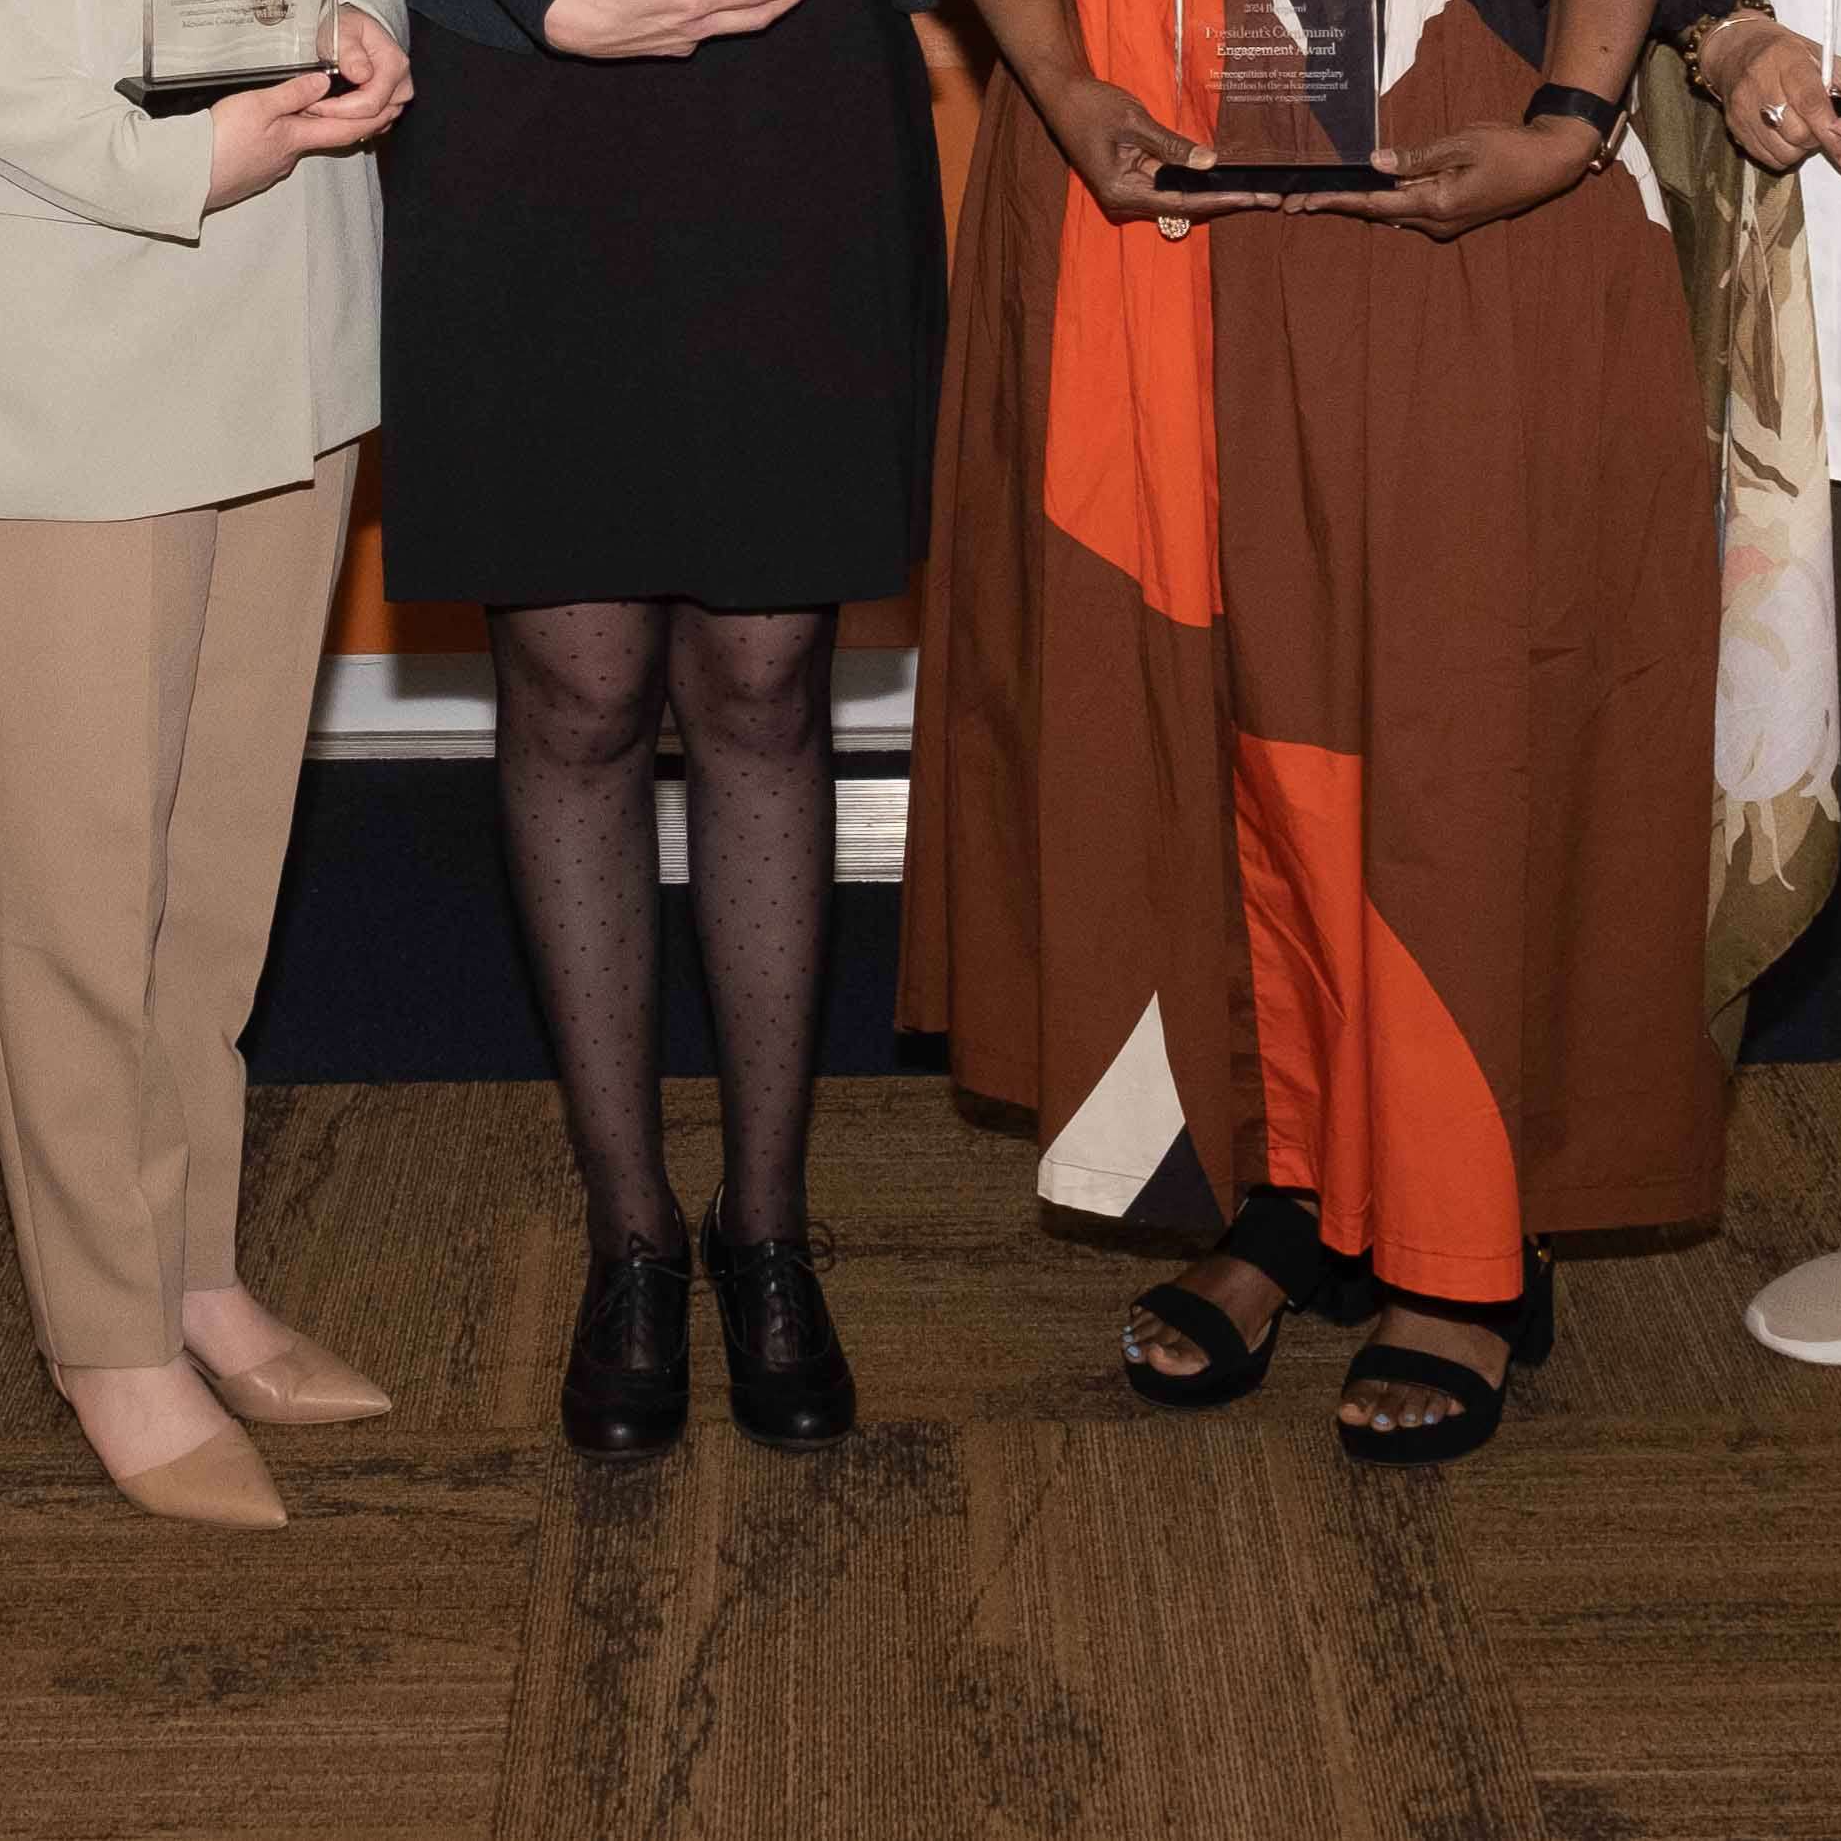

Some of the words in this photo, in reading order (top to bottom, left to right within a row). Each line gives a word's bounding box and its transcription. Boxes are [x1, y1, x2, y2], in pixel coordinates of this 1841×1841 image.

[1205, 26, 1272, 39] President's
[1273, 25, 1346, 41] Comunity
[1216, 42, 1294, 60] Engagement
